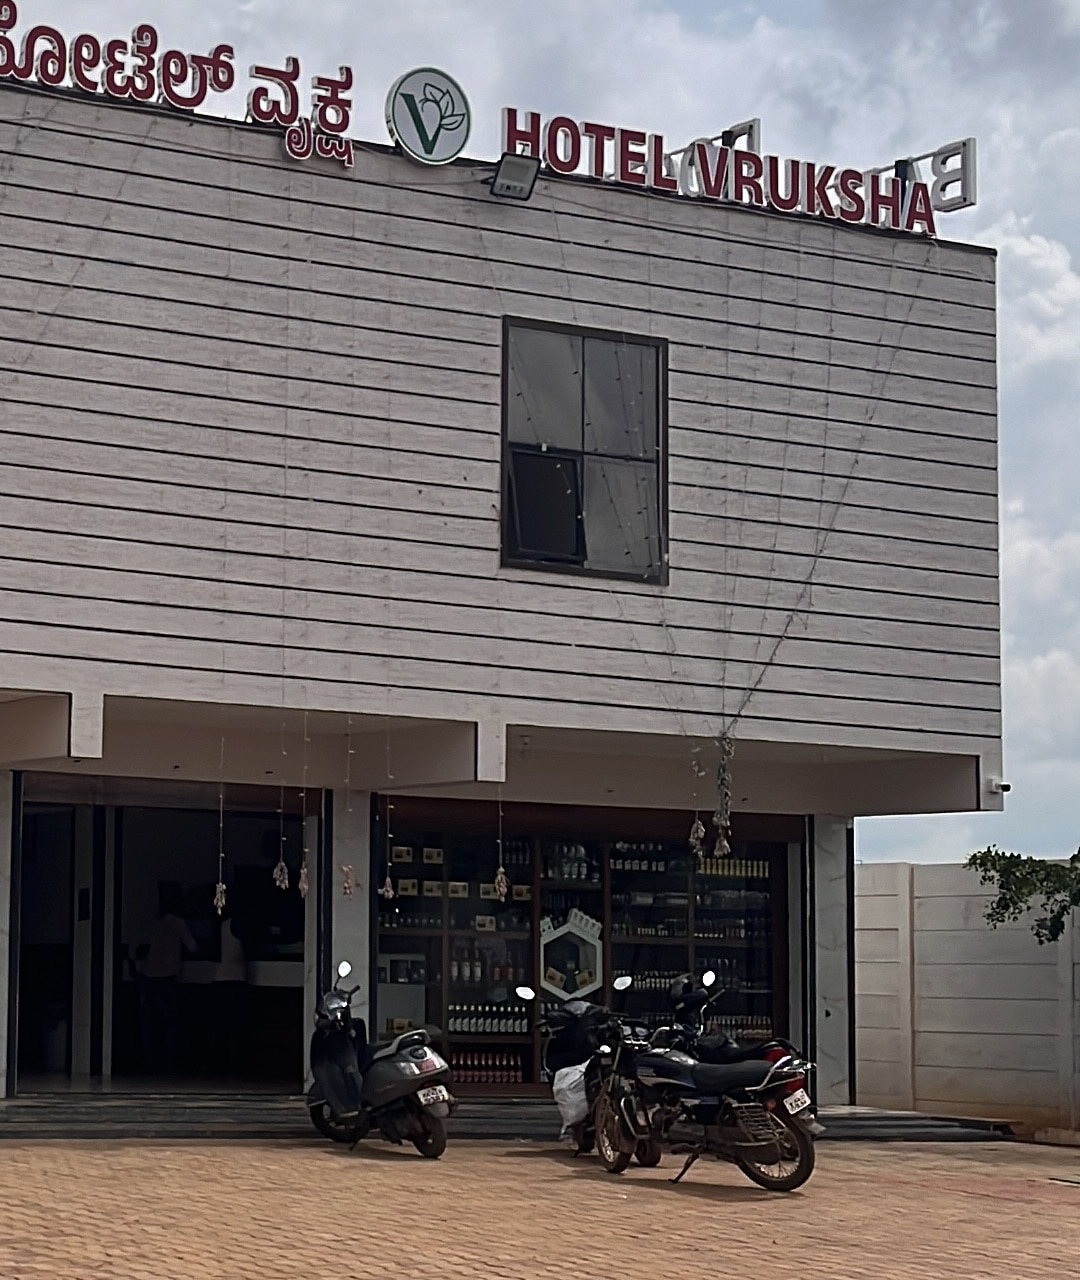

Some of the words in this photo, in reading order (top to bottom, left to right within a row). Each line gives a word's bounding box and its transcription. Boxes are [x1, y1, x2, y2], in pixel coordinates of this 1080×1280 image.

[248, 56, 354, 167] ವೃಕ್ಷ
[502, 107, 678, 191] HOTEL
[695, 142, 936, 236] VRUKSHA
